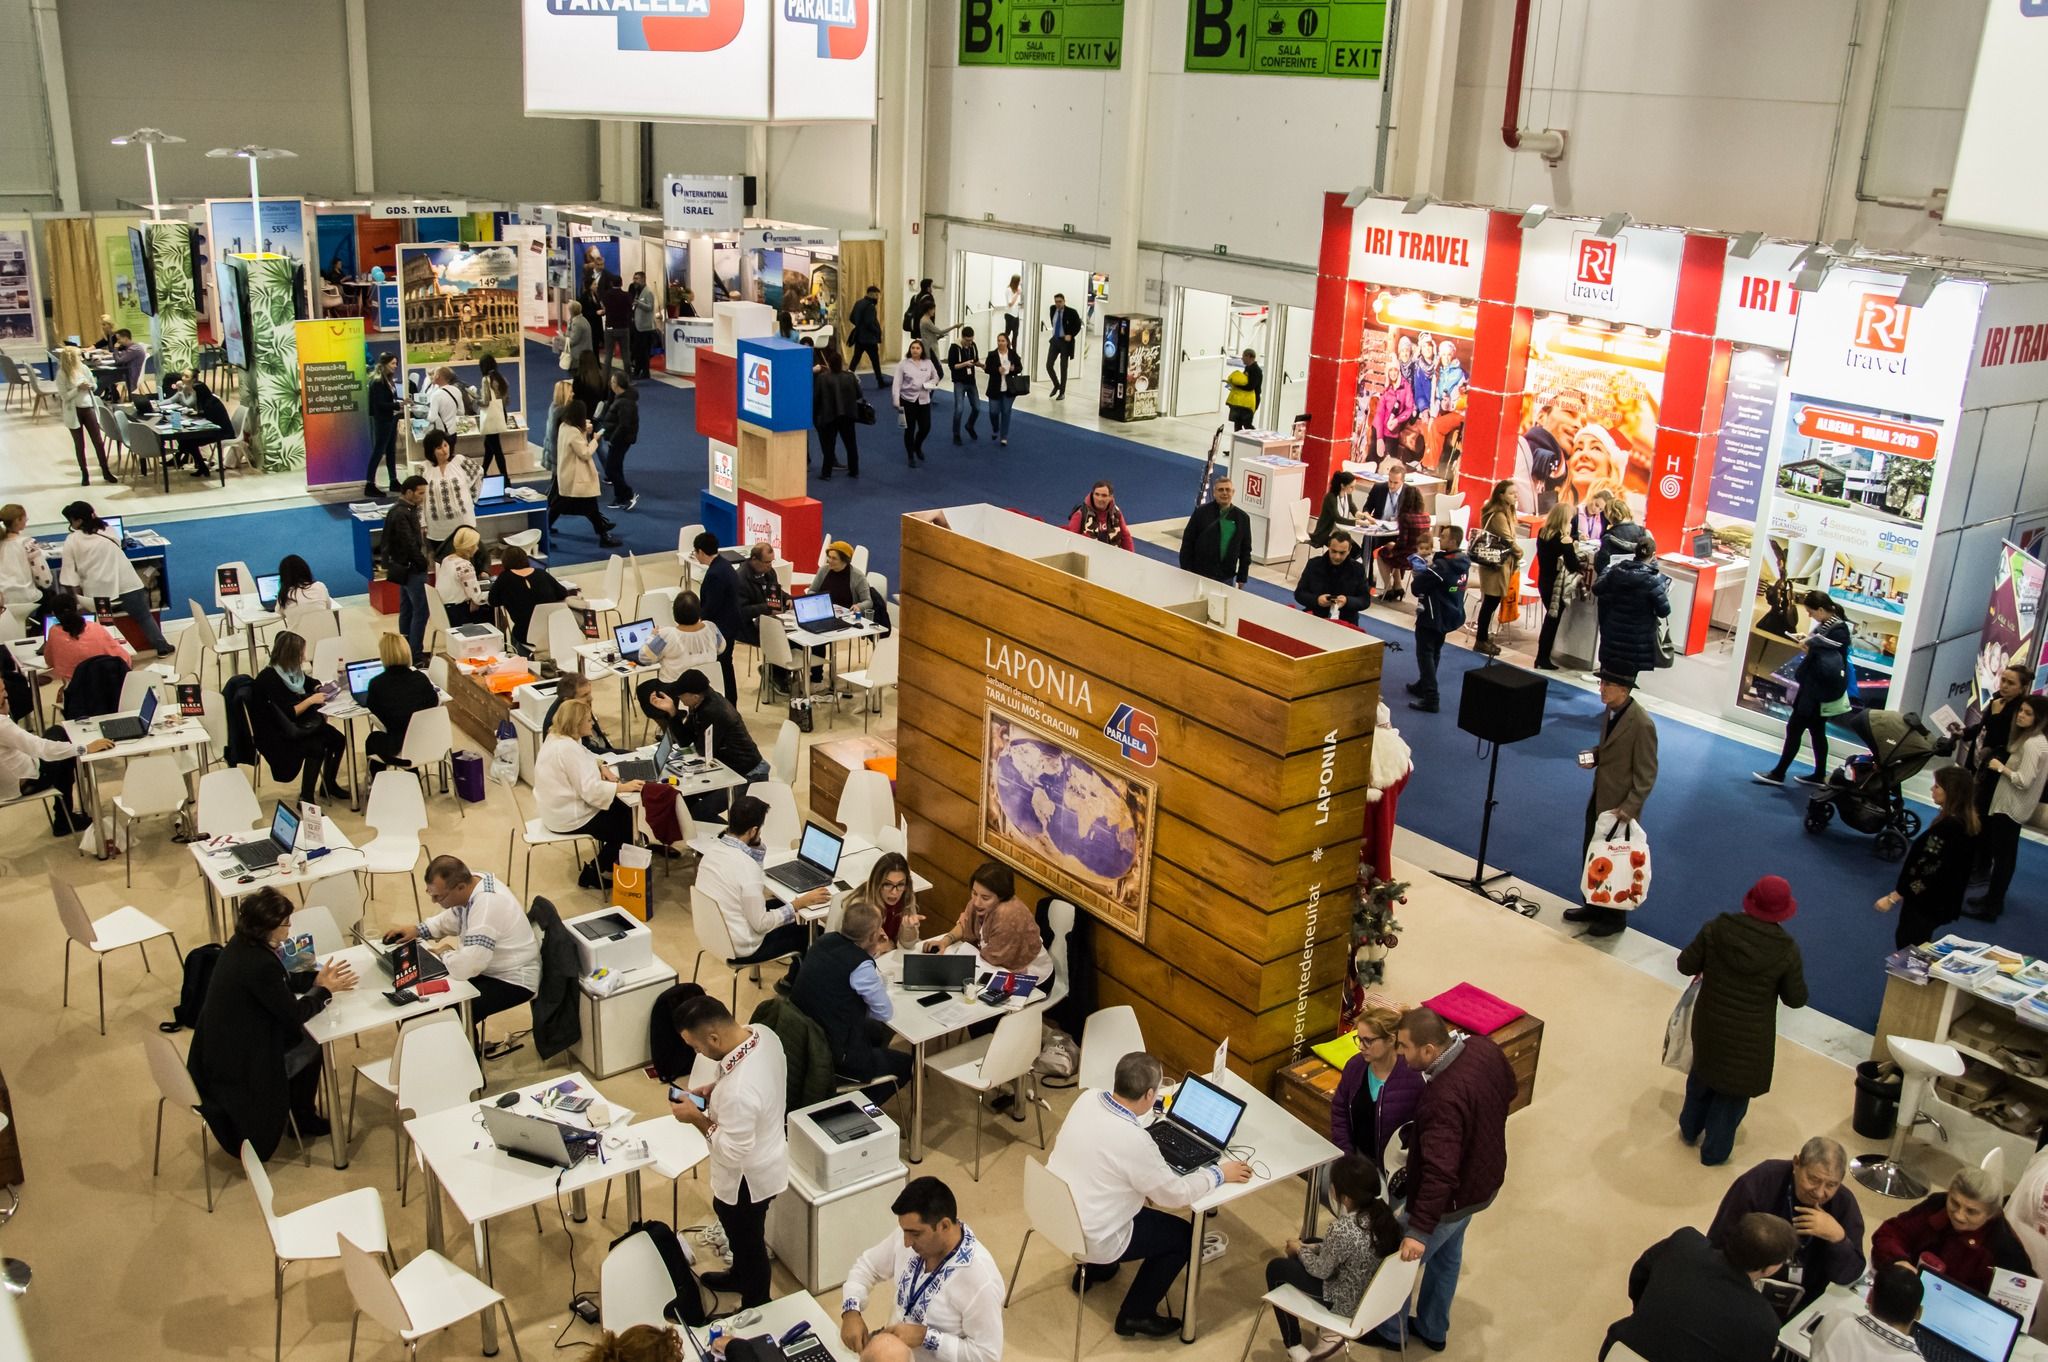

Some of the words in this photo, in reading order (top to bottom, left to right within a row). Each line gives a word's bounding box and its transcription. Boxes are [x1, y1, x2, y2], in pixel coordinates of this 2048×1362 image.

[1026, 41, 1044, 50] SALA
[1068, 43, 1101, 60] EXIT
[1278, 45, 1301, 56] SALA
[1014, 51, 1056, 61] CONFERINTE
[1261, 56, 1318, 69] CONFERINTE
[1335, 48, 1382, 68] EXIT
[684, 190, 728, 198] INTERNATIONAL
[413, 206, 452, 214] TRAVEL
[683, 206, 714, 215] ISRAEL
[1365, 226, 1393, 256] IRI
[1398, 230, 1469, 267] TRAVEL
[1572, 282, 1614, 302] travel
[1739, 276, 1781, 312] IRI
[1980, 326, 2011, 367] IRI
[1846, 348, 1908, 376] travel
[314, 373, 353, 381] newsletterul
[308, 405, 331, 413] premiu
[1890, 432, 1920, 449] 2019
[1879, 531, 1920, 549] albena
[985, 637, 1093, 715] LAPONIA
[986, 685, 1007, 705] TARA
[1007, 695, 1021, 710] LUI
[1020, 701, 1041, 721] MOS
[1041, 712, 1080, 740] CRACIUN
[1106, 726, 1149, 754] PARALELA
[1315, 728, 1339, 827] LAPONIA
[395, 964, 417, 980] BLACK
[395, 969, 418, 988] FRIDAY
[1291, 882, 1322, 1065] experientedeneuitat
